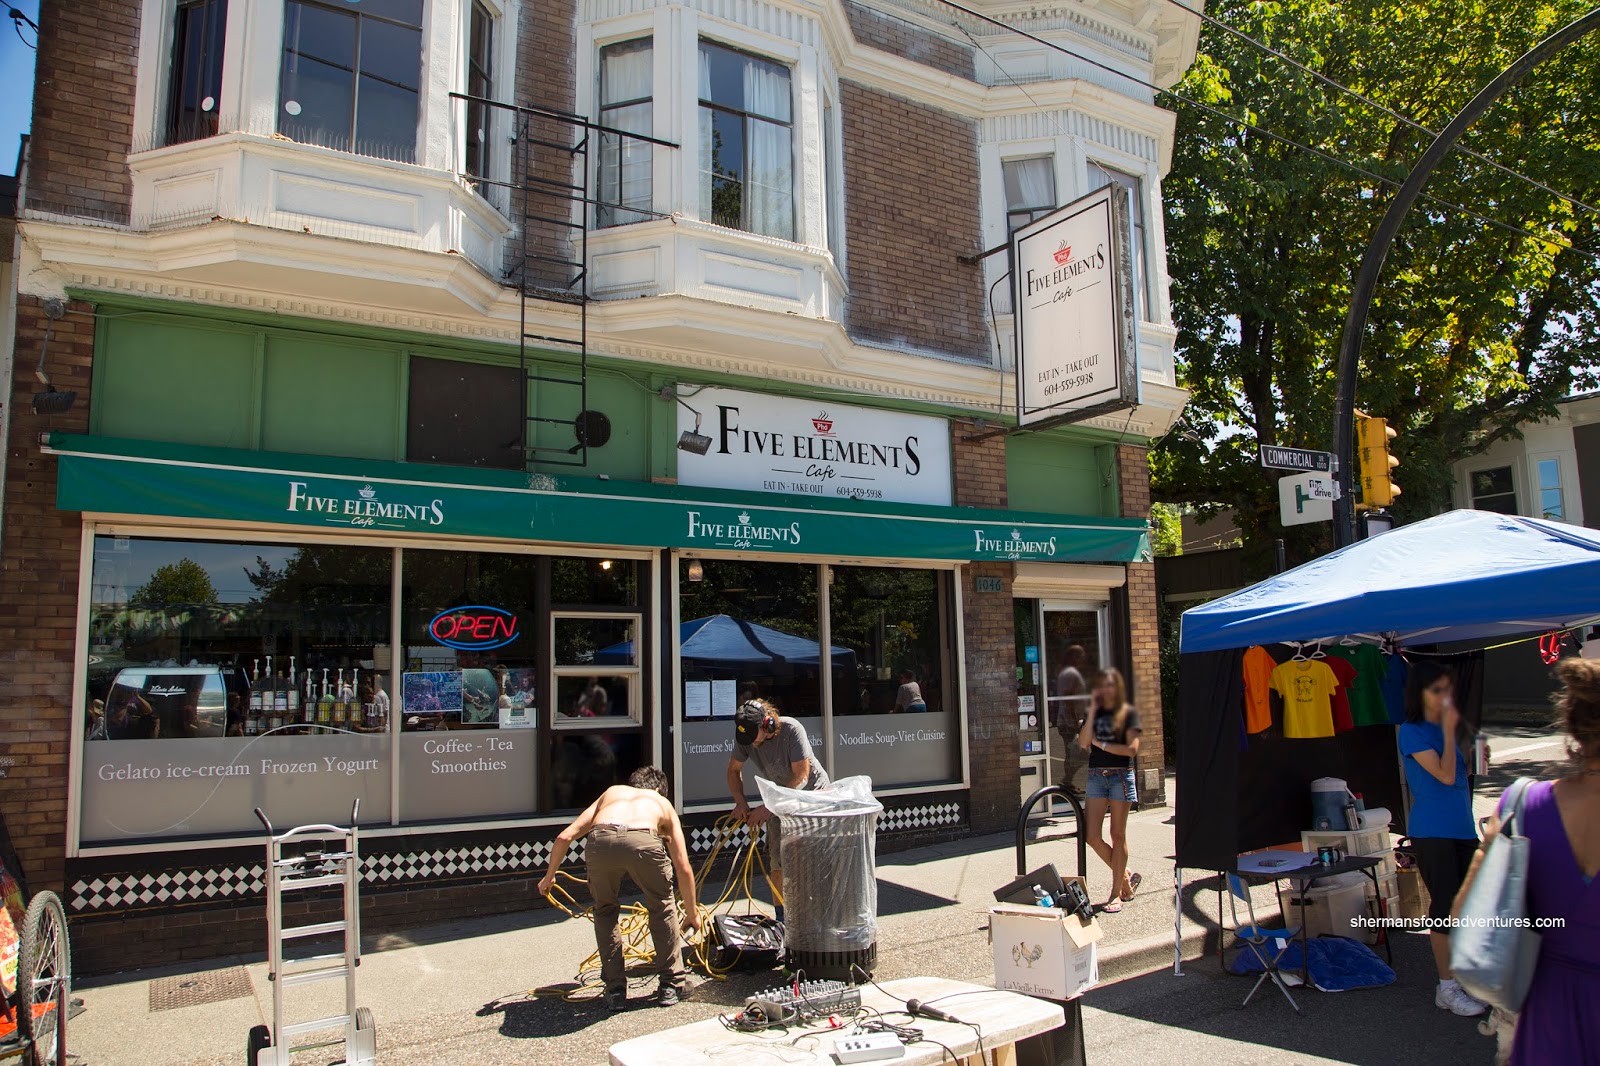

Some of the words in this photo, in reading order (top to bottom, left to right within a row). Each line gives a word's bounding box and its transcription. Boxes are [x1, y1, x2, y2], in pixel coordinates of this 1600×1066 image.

[1026, 269, 1051, 297] FIVE
[1053, 243, 1105, 285] ELEMENTS
[1053, 286, 1074, 304] Cafe
[1038, 370, 1051, 383] EAT
[1052, 366, 1060, 379] IN
[1065, 359, 1083, 374] TAKE
[1084, 354, 1098, 368] OUT
[1044, 372, 1094, 397] 604-559-5938
[716, 404, 784, 457] FIVE
[793, 435, 921, 476] ELEMENTS
[1268, 449, 1314, 468] COMMERCIAL
[805, 464, 837, 481] Cafe
[763, 480, 776, 490] EAT
[777, 481, 786, 491] IN
[791, 482, 808, 493] TAKE
[810, 484, 824, 494] OUT
[836, 486, 882, 499] 604-559-5938
[1314, 486, 1332, 498] drive
[286, 481, 339, 513] FIVE
[343, 498, 444, 526] ELEMENTS
[351, 516, 376, 528] Cafe
[687, 511, 724, 538] FIVE
[727, 522, 800, 545] ELEMENTS
[733, 539, 752, 550] Cafe
[973, 529, 1002, 553] FIVE
[1004, 536, 1057, 556] ELEMENTS
[1007, 552, 1020, 561] Cafe
[978, 578, 1001, 592] 1046
[432, 615, 517, 639] OPEN
[423, 739, 473, 754] Coffee
[485, 737, 514, 751] Tea
[839, 732, 874, 746] Noodles
[875, 730, 916, 747] Soup-Viet
[916, 729, 946, 741] Cuisine
[683, 741, 723, 754] Vietnamese
[98, 763, 161, 781] Gelato
[166, 762, 251, 778] ice-cream
[260, 758, 318, 775] Frozen
[323, 756, 379, 776] Yogurt
[431, 758, 507, 774] Smoothies
[1003, 980, 1012, 989] La
[1013, 982, 1033, 993] Vieille
[1034, 985, 1055, 995] Ferme
